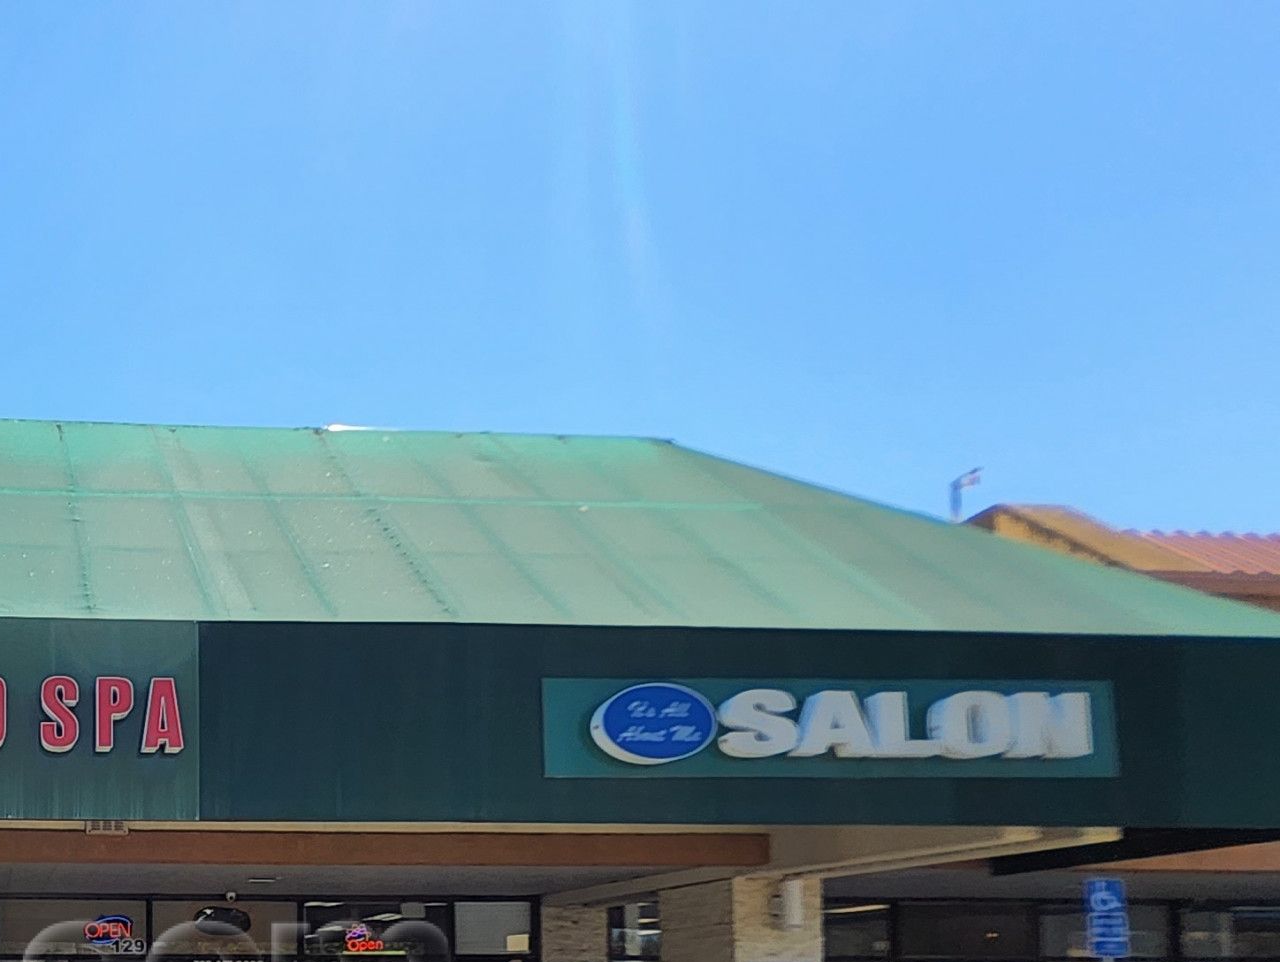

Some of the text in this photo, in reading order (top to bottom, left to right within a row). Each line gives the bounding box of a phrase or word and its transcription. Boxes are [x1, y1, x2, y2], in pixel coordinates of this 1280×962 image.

[40, 675, 184, 753] SPA
[717, 689, 1094, 759] SALON
[84, 922, 132, 938] OPEN
[112, 939, 145, 953] 129
[347, 939, 384, 951] Open
